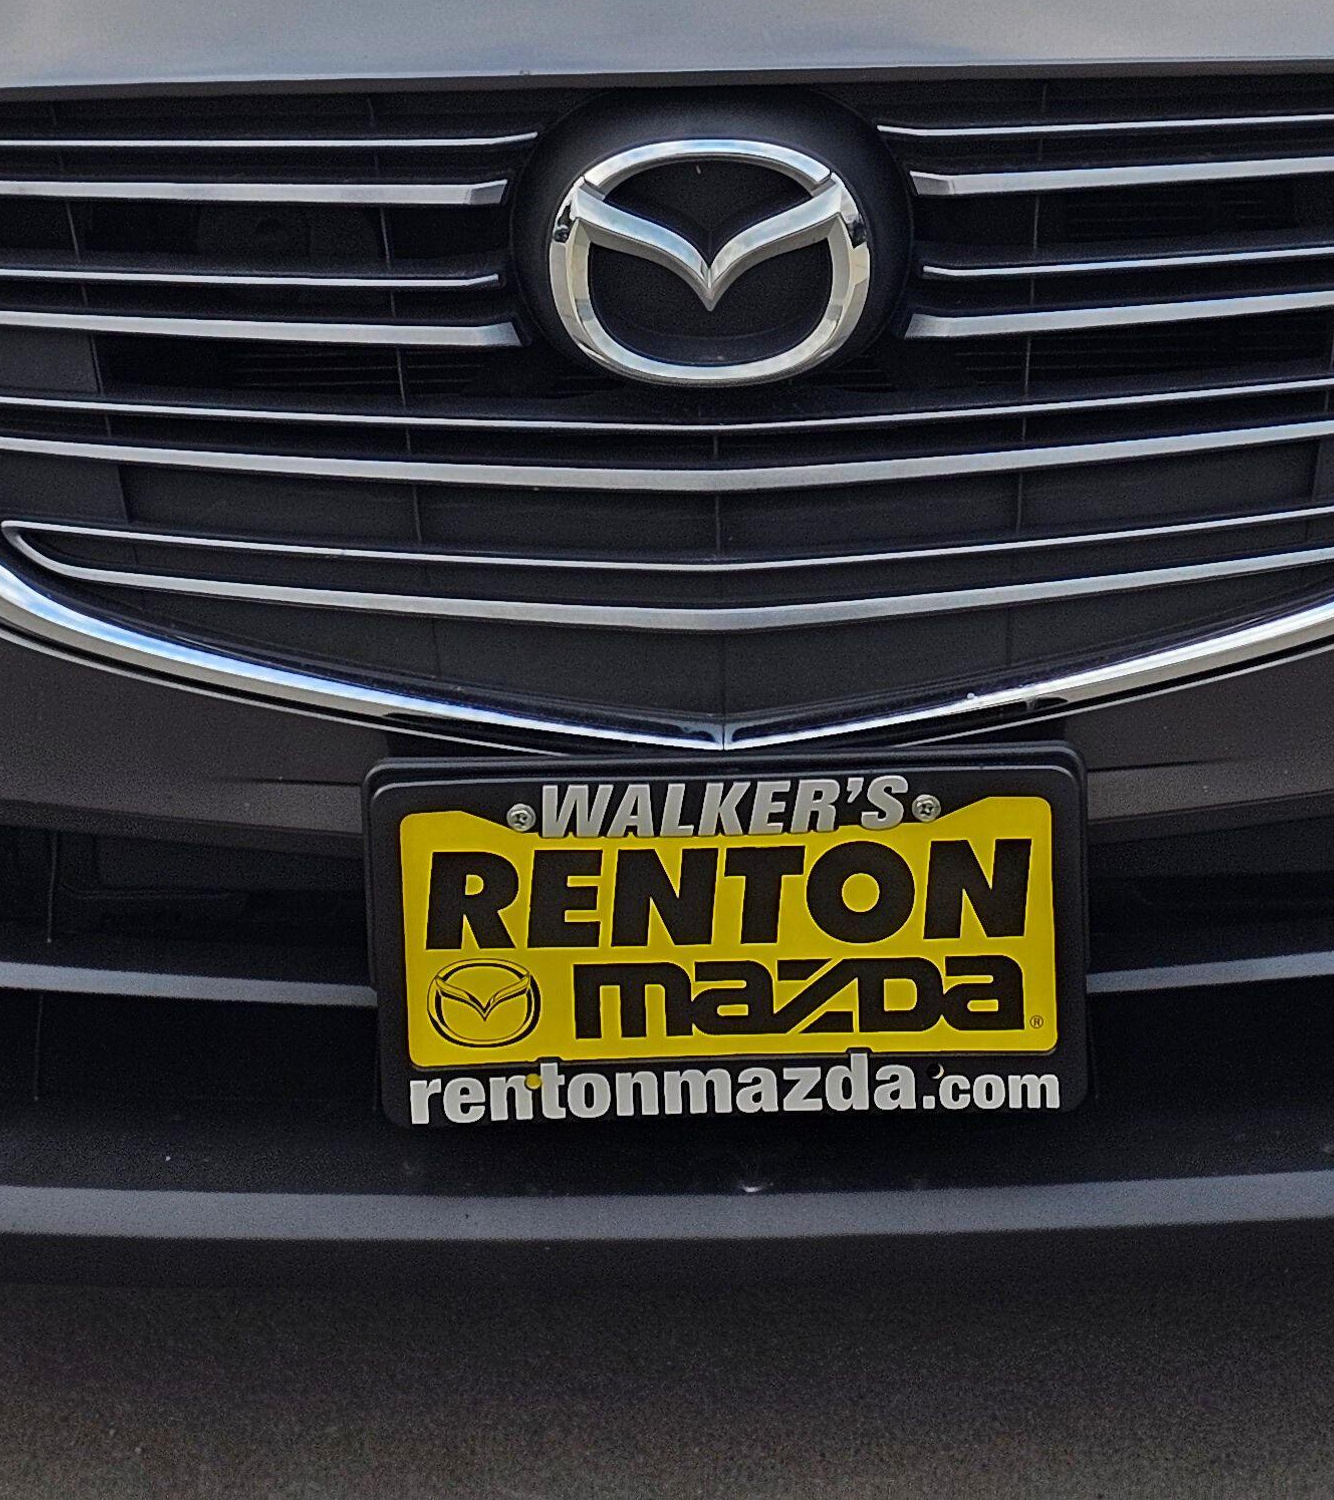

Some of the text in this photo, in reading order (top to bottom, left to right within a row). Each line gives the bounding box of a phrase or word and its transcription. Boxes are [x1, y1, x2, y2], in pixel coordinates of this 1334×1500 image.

[541, 776, 909, 838] WALKER'S
[426, 839, 1032, 949] RENTON
[409, 1054, 1060, 1124] rentonmazda.com
